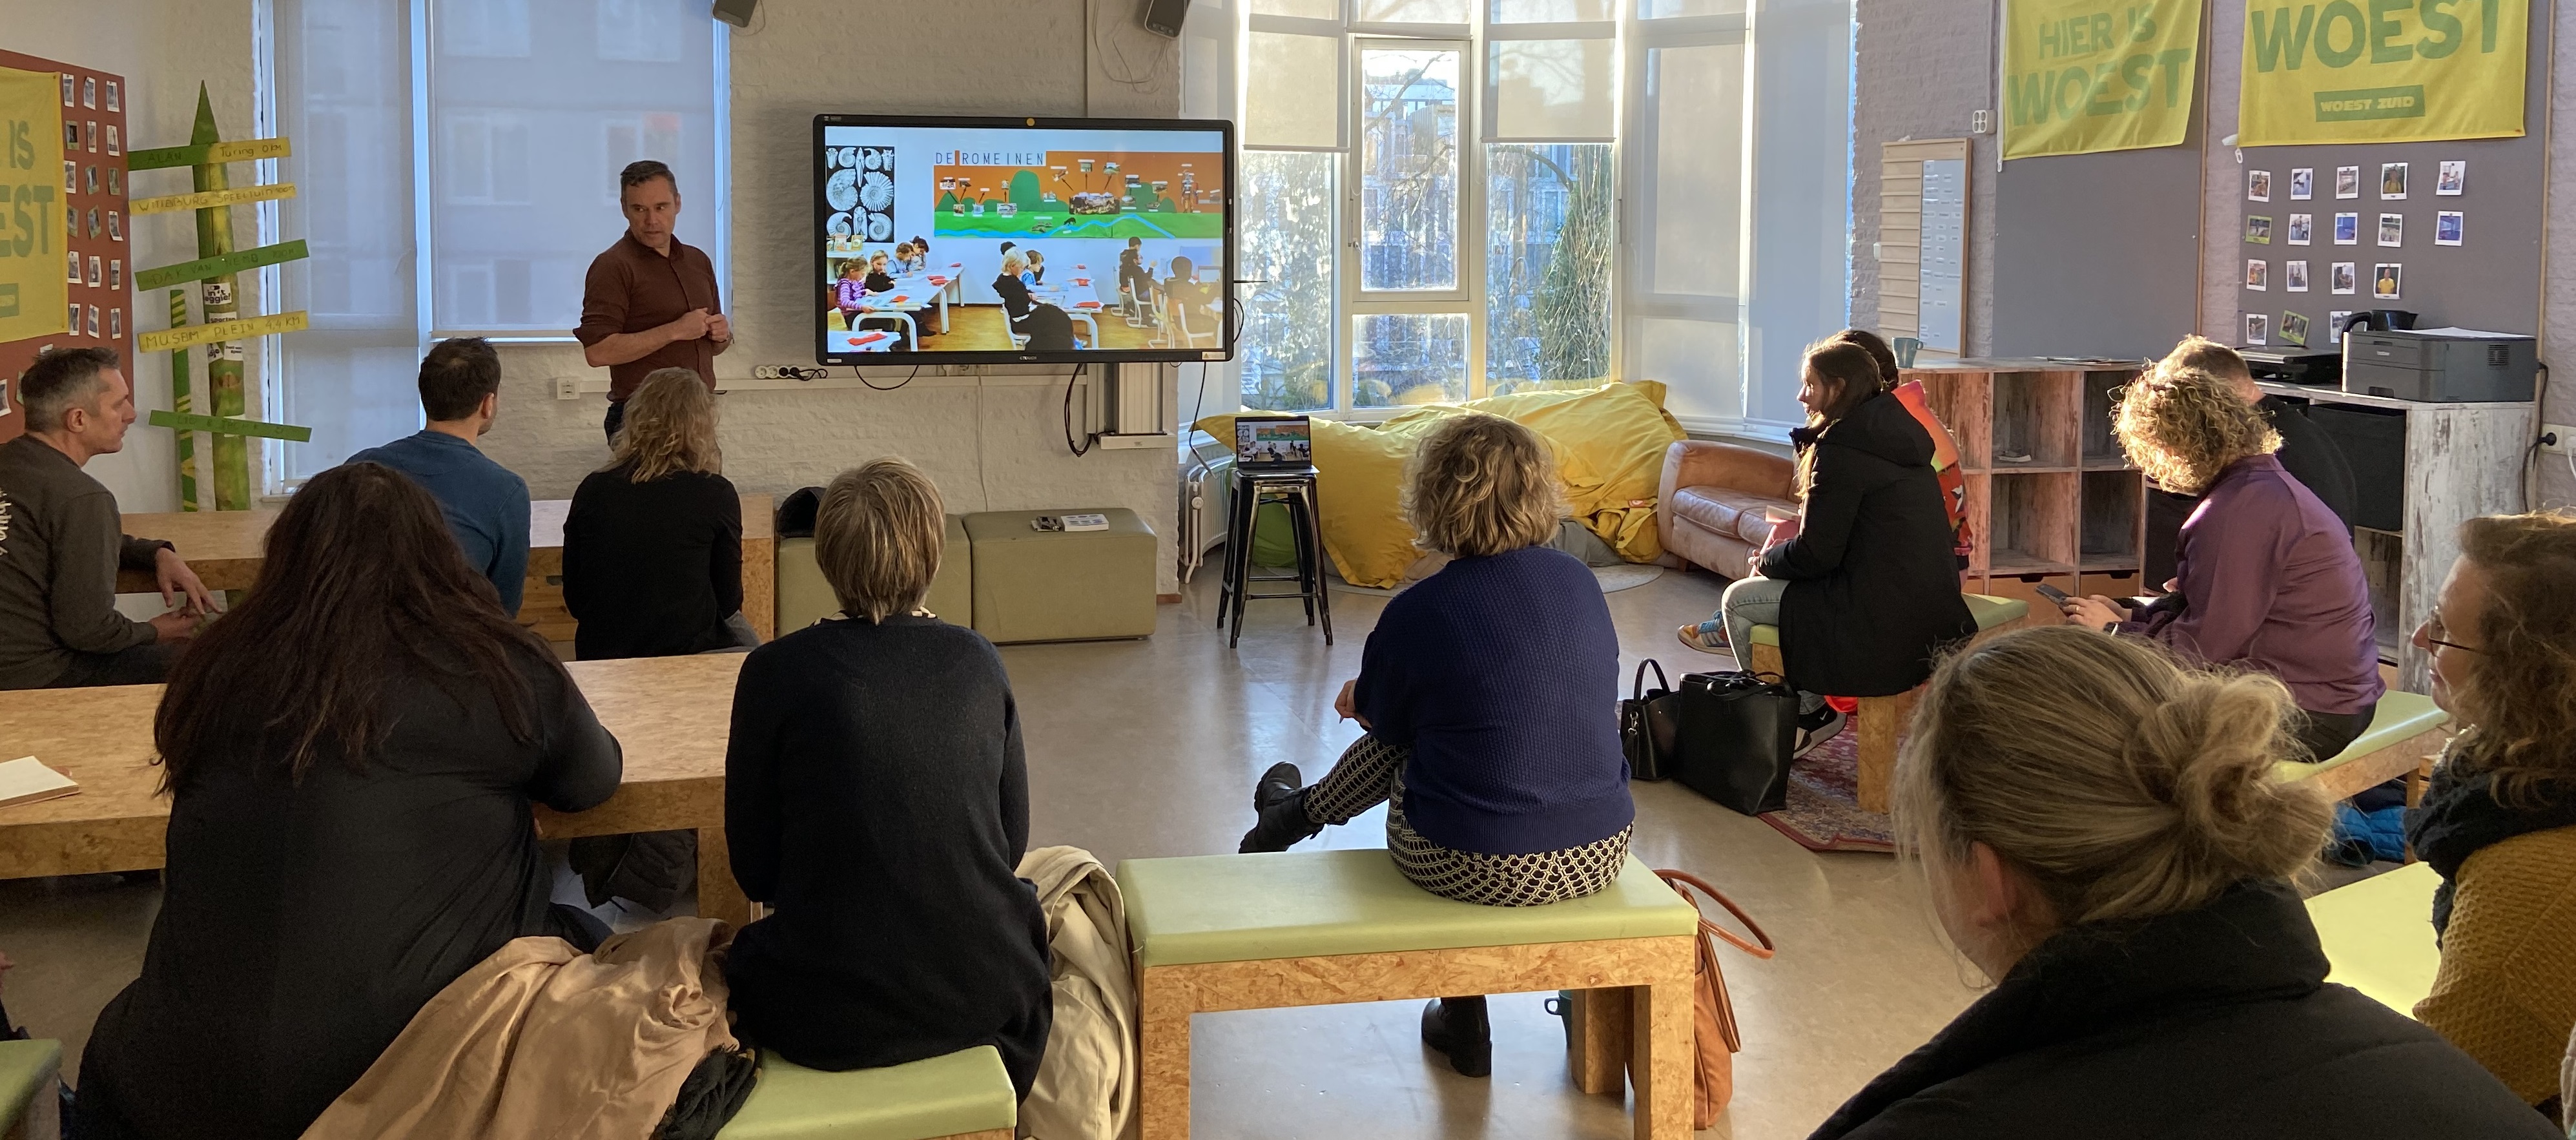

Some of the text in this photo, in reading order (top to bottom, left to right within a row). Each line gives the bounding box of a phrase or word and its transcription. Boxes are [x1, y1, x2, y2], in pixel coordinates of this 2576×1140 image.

[2039, 3, 2157, 59] HIER IS
[2251, 0, 2499, 72] WOEST
[2008, 48, 2190, 126] WOEST
[2320, 96, 2415, 112] WOEST ZUID
[9, 119, 35, 170] IS
[220, 147, 254, 157] Turing
[936, 152, 1044, 165] DE ROMEINEN
[214, 324, 254, 337] PLEIN
